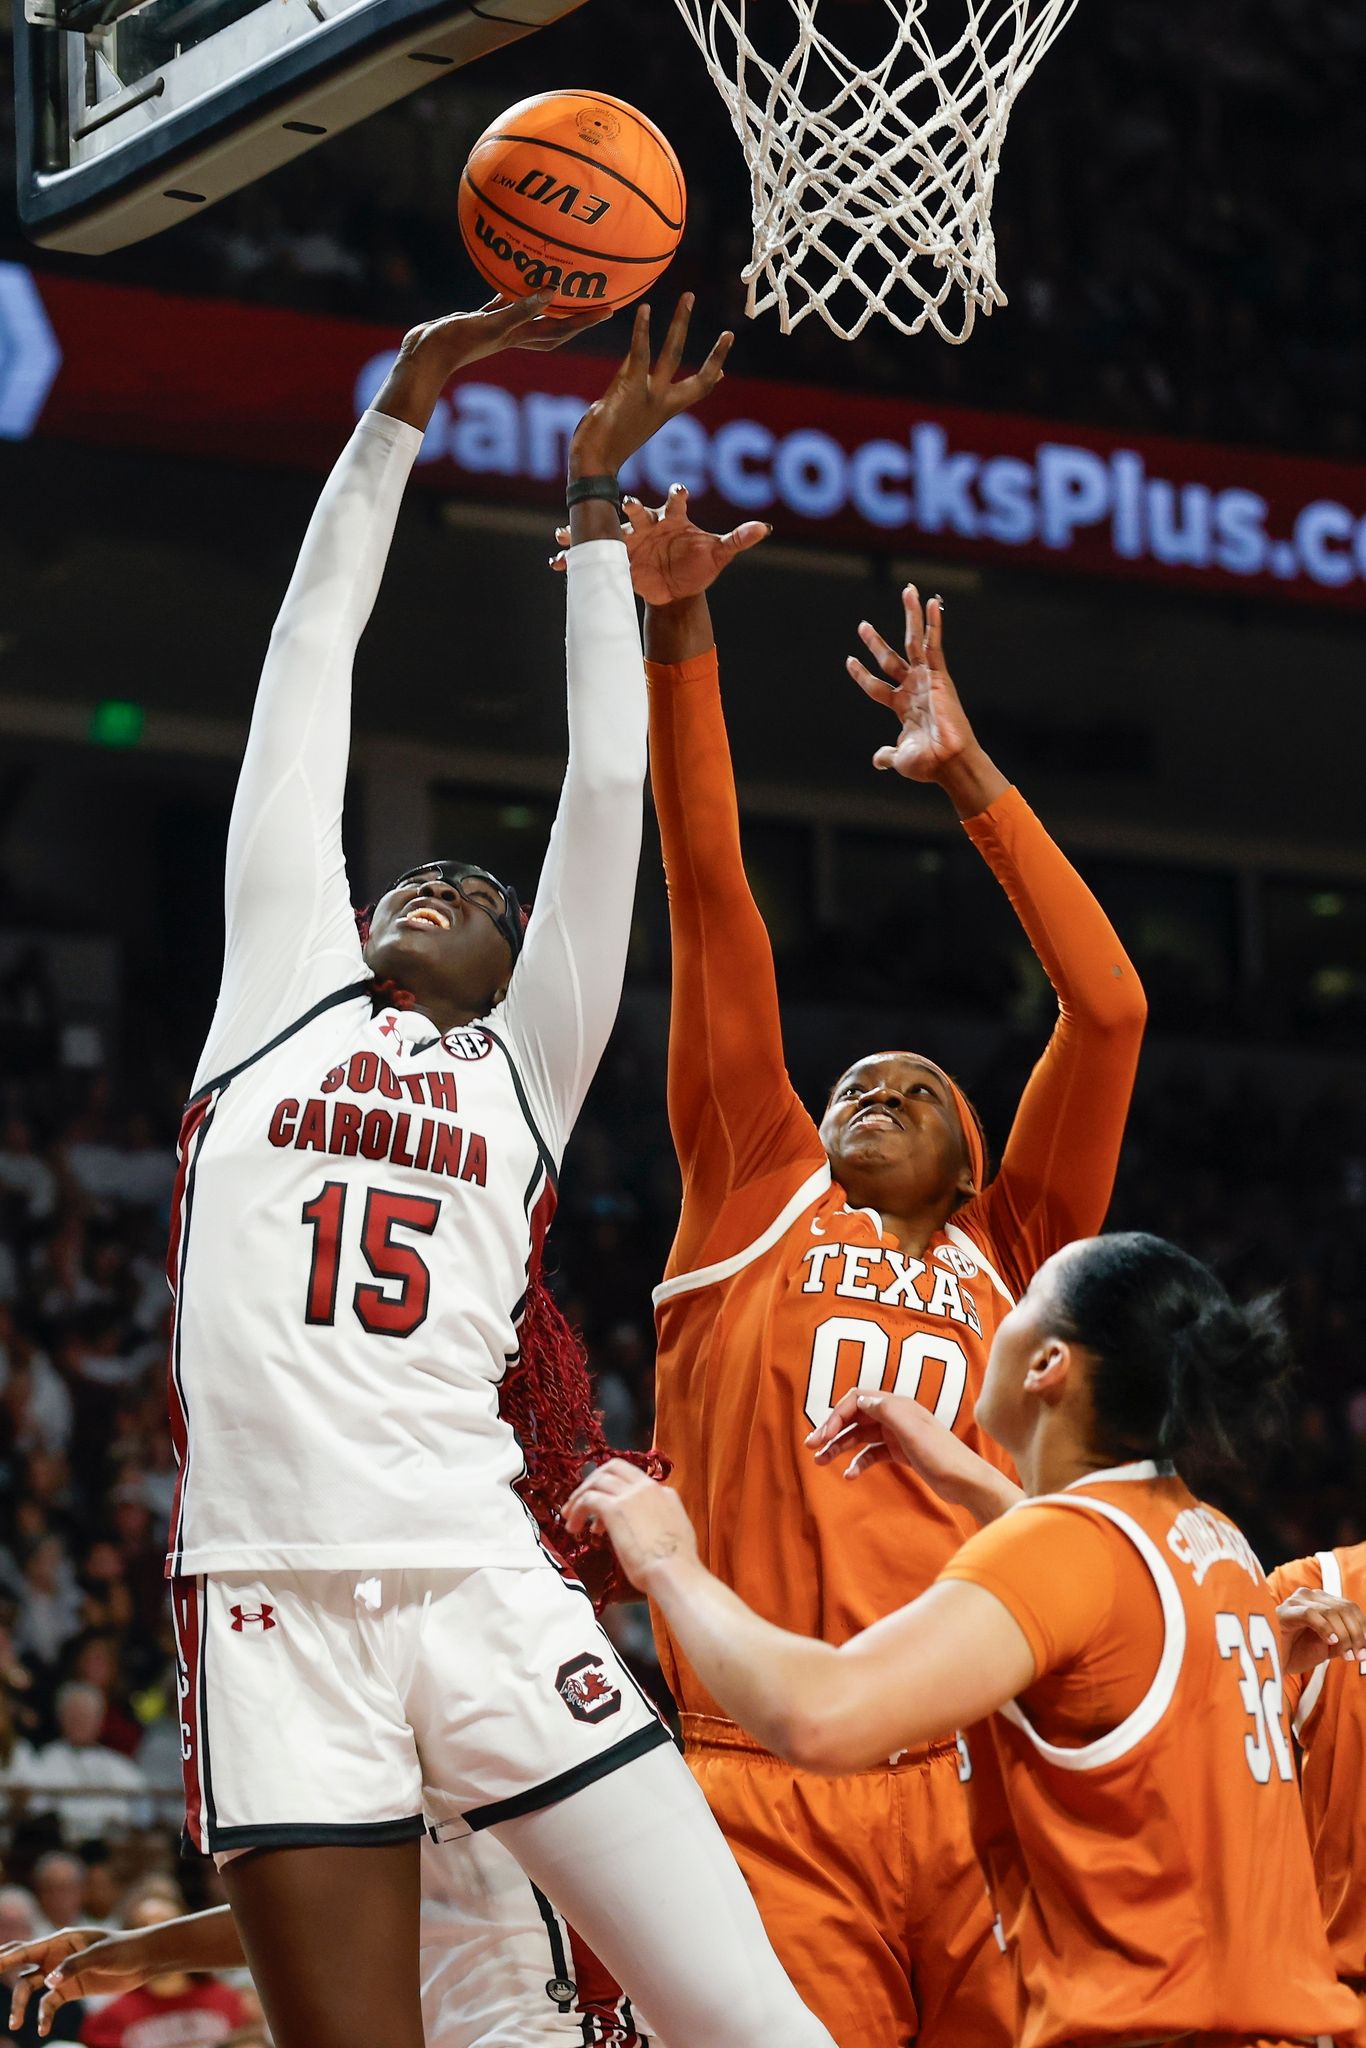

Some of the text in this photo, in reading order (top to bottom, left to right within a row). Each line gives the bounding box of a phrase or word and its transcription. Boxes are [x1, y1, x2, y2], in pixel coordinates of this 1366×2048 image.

[491, 168, 611, 225] EVO NXT
[320, 1051, 458, 1113] SOUTH
[444, 1032, 490, 1060] SEC
[268, 1098, 488, 1187] CAROLINA
[301, 1180, 441, 1339] 15
[803, 1242, 983, 1340] TEXAS
[934, 1245, 977, 1278] SEC
[804, 1316, 968, 1432] 00
[1215, 1611, 1293, 1784] 32
